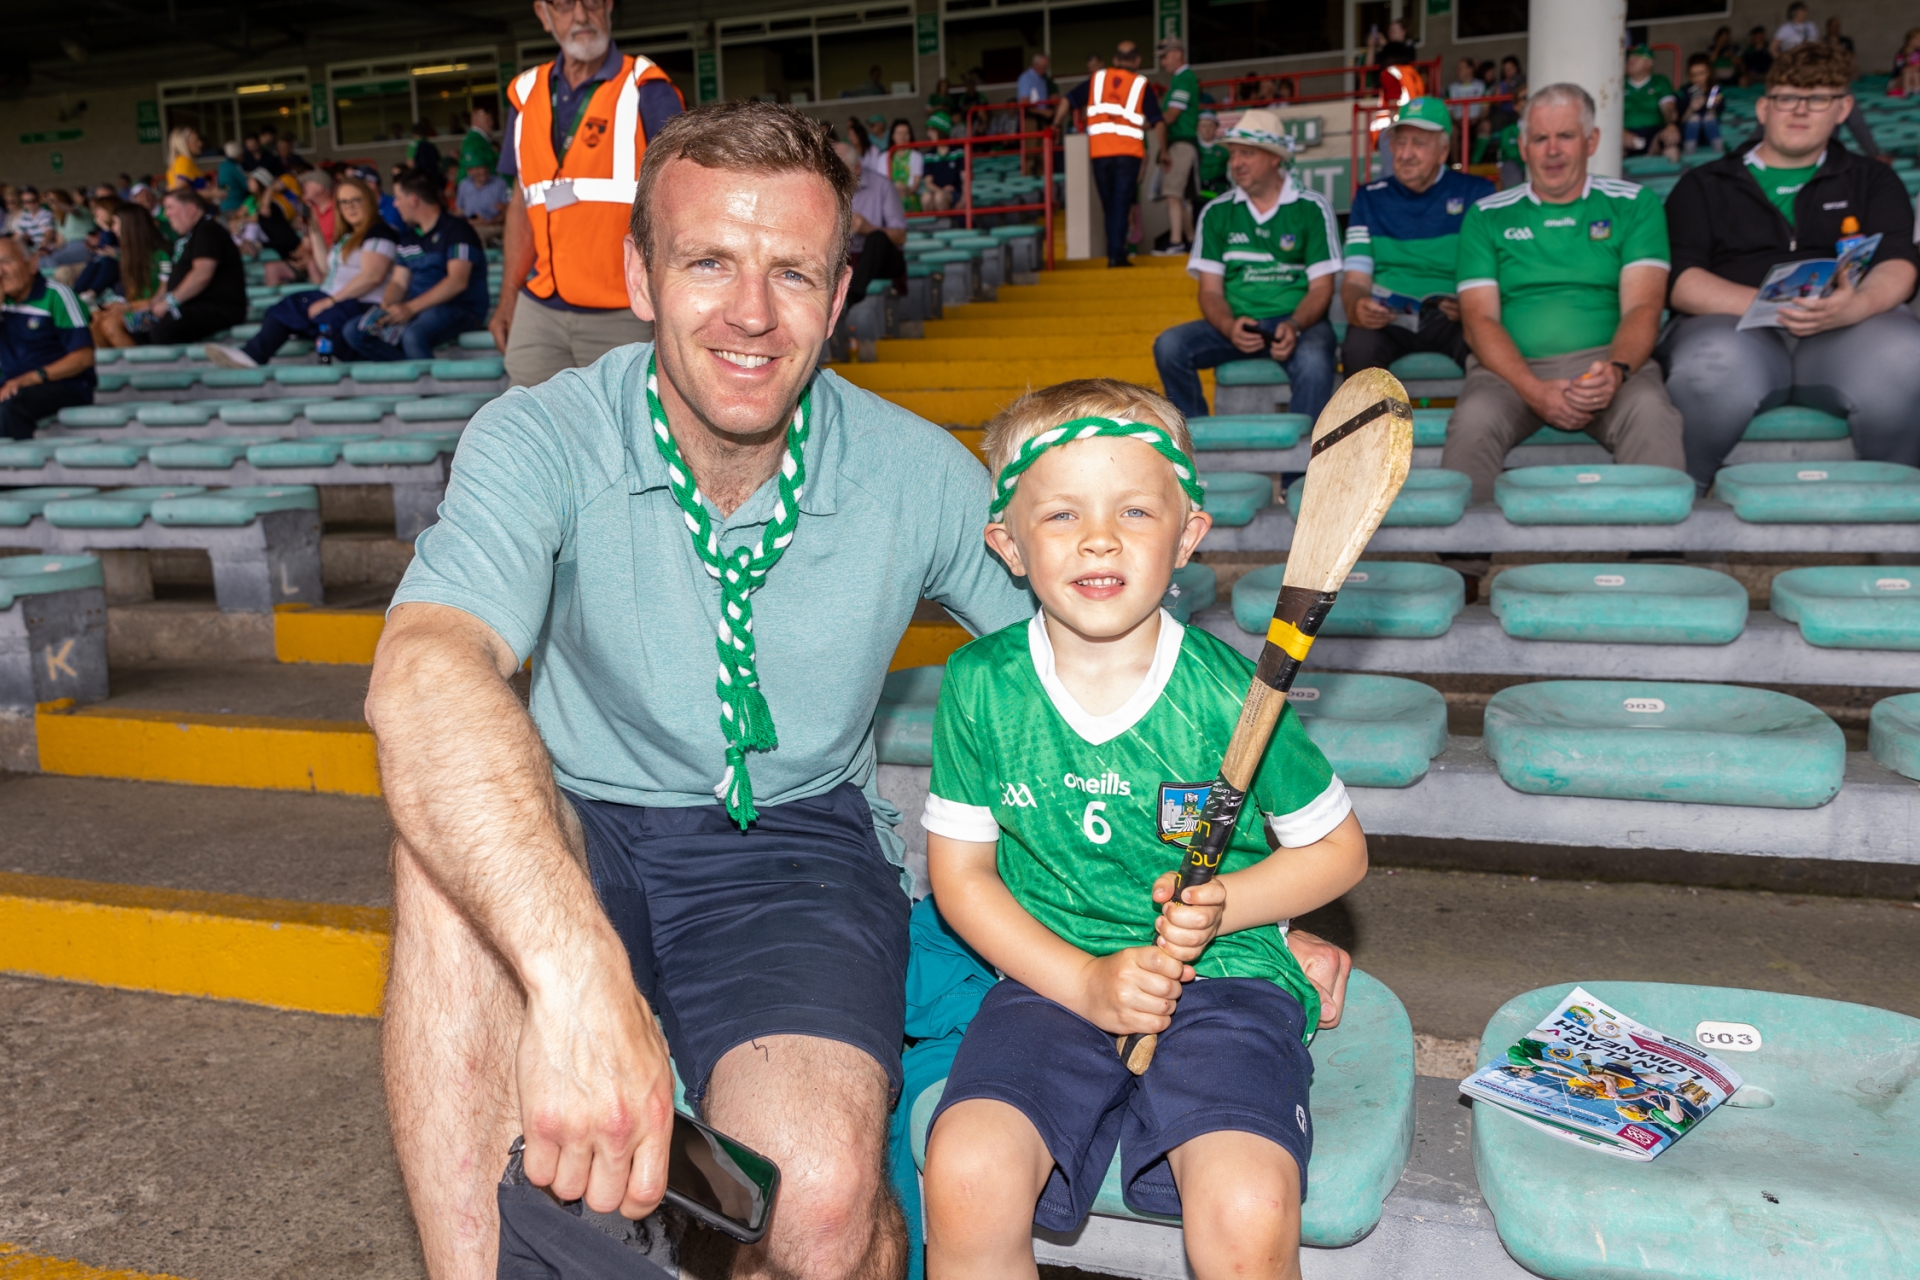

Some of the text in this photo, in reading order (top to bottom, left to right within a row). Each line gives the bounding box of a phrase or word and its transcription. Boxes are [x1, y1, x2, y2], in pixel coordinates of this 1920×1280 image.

[280, 563, 299, 595] L
[45, 640, 77, 681] K
[1001, 783, 1038, 808] AA
[1064, 772, 1131, 796] oneills
[1083, 801, 1112, 845] 6
[1552, 1019, 1703, 1081] LUIMNEACH
[1699, 1032, 1753, 1045] 003
[1631, 1059, 1677, 1075] AN
